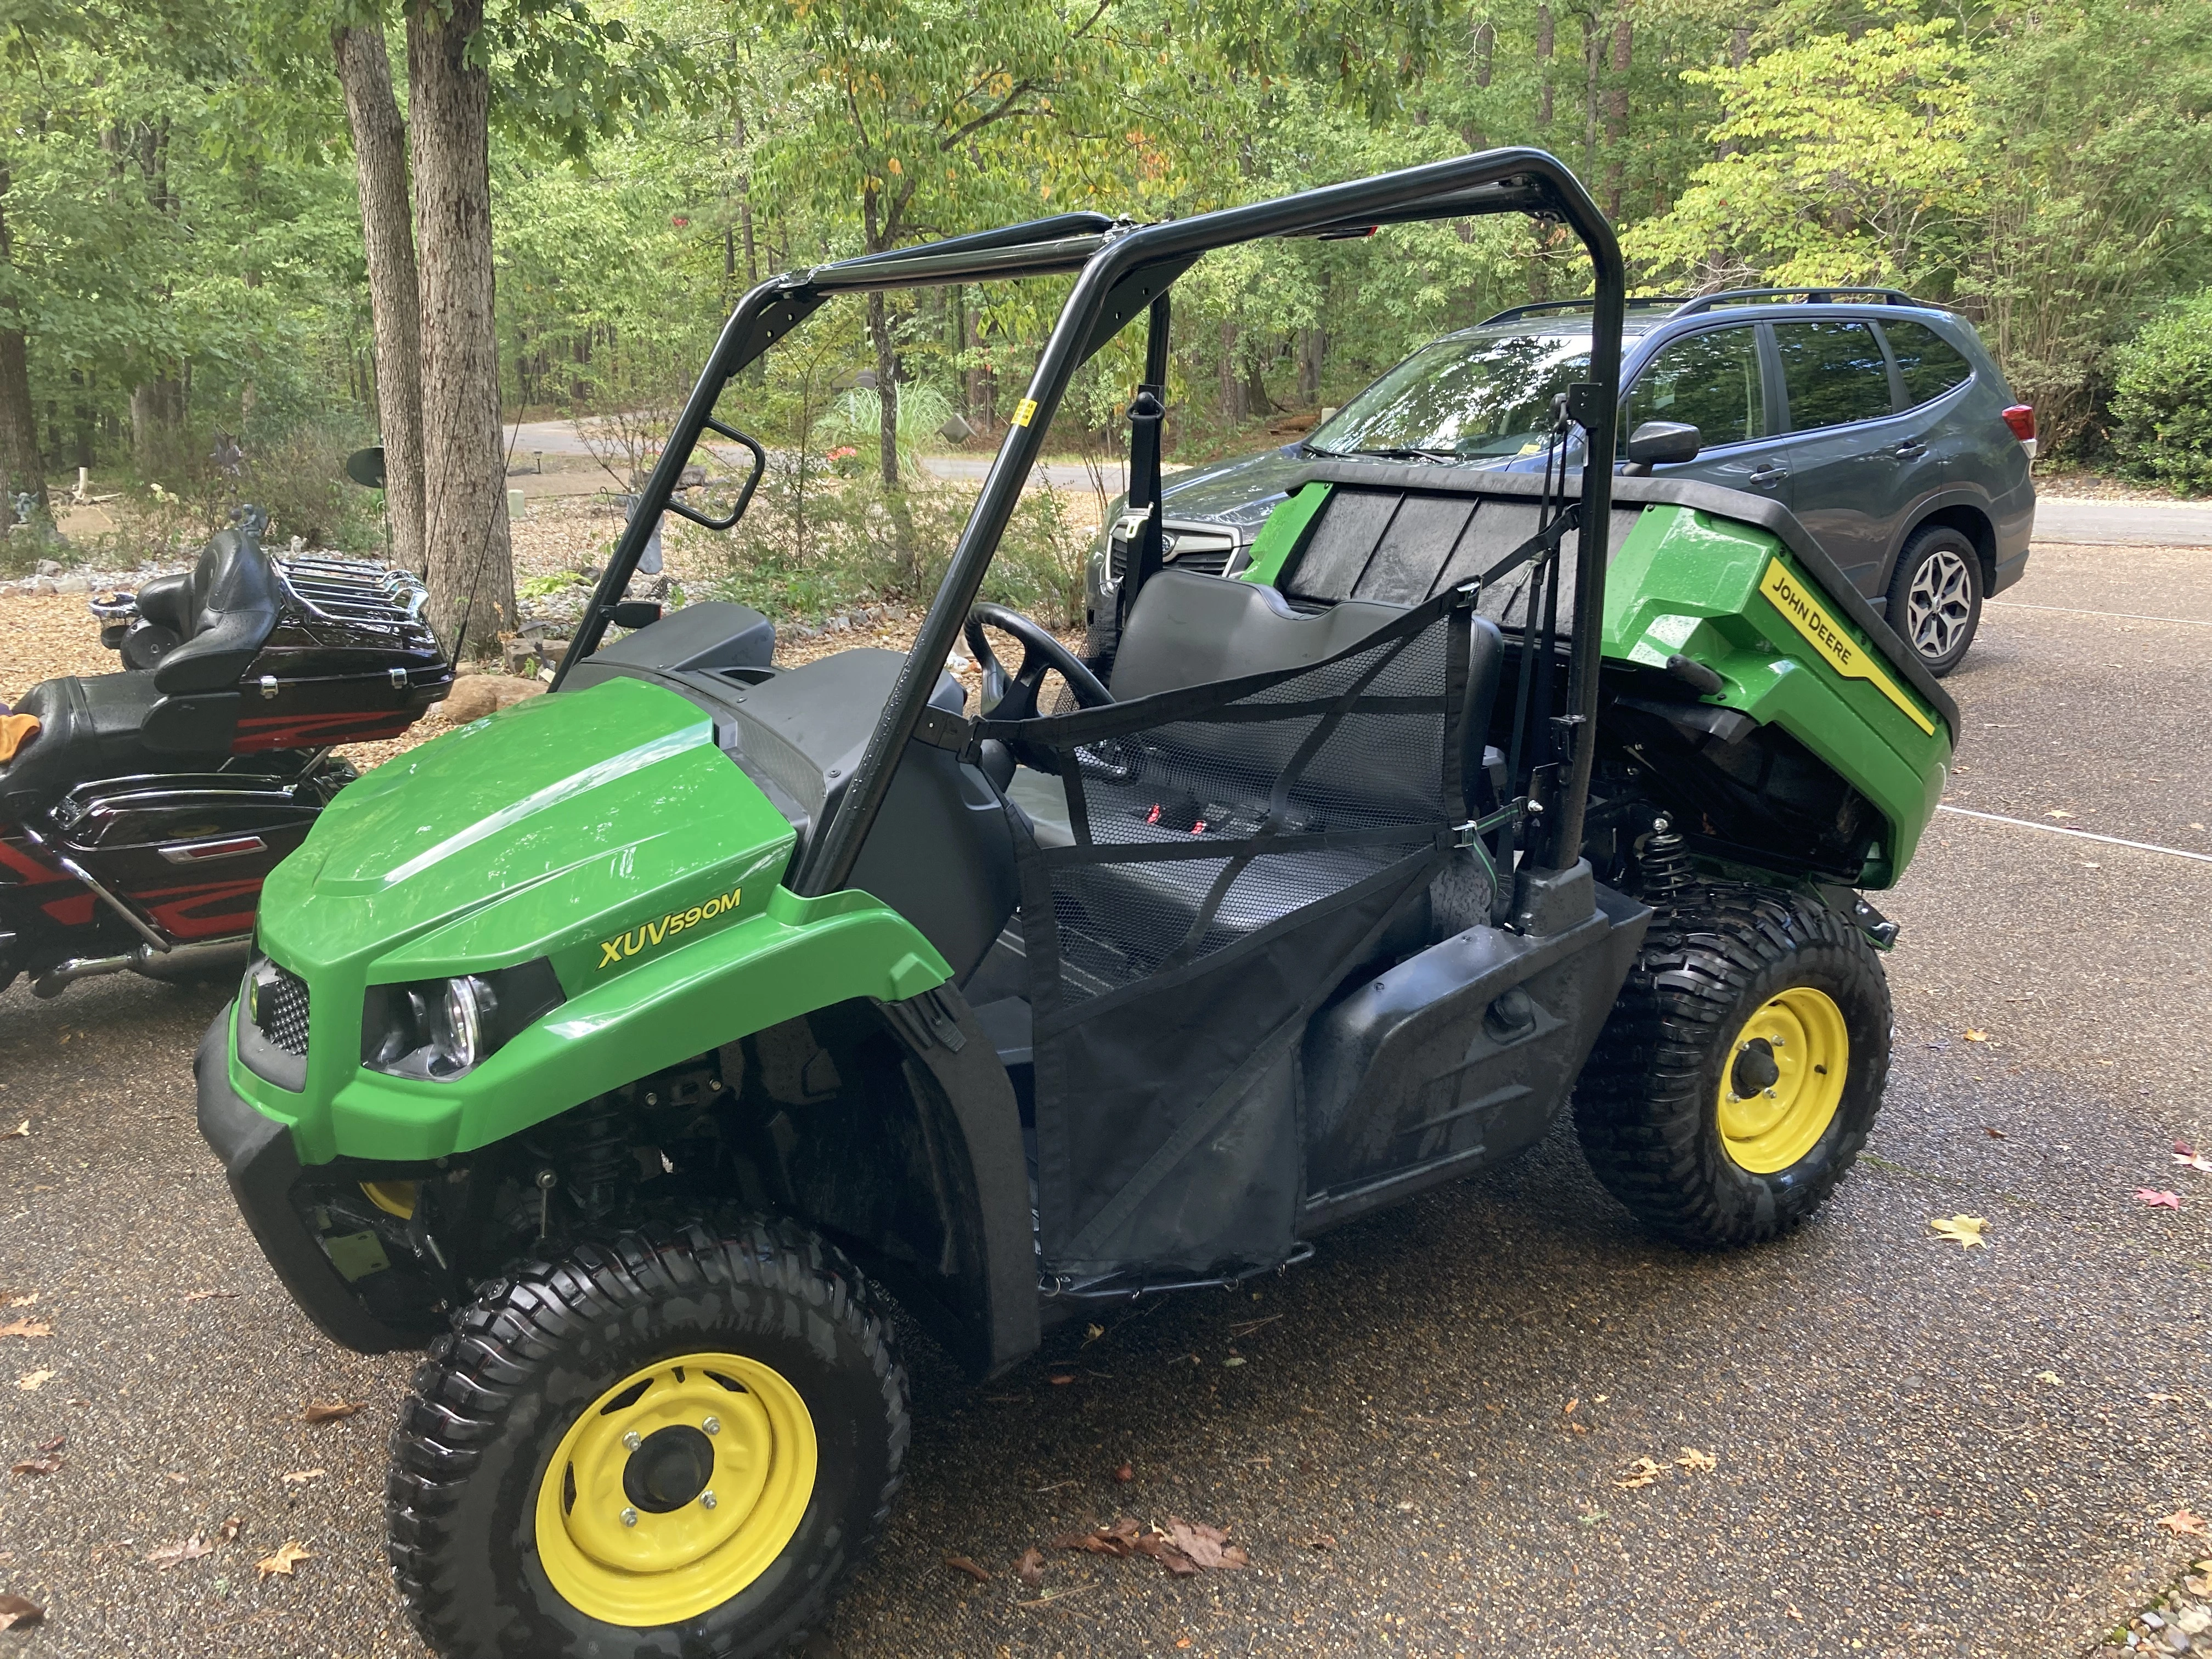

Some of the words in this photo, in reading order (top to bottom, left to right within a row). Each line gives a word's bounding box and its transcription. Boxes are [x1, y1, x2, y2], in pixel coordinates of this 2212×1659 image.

[1773, 577, 1809, 620] JOHN
[1808, 612, 1852, 665] DEERE
[597, 887, 742, 970] XUV590M
